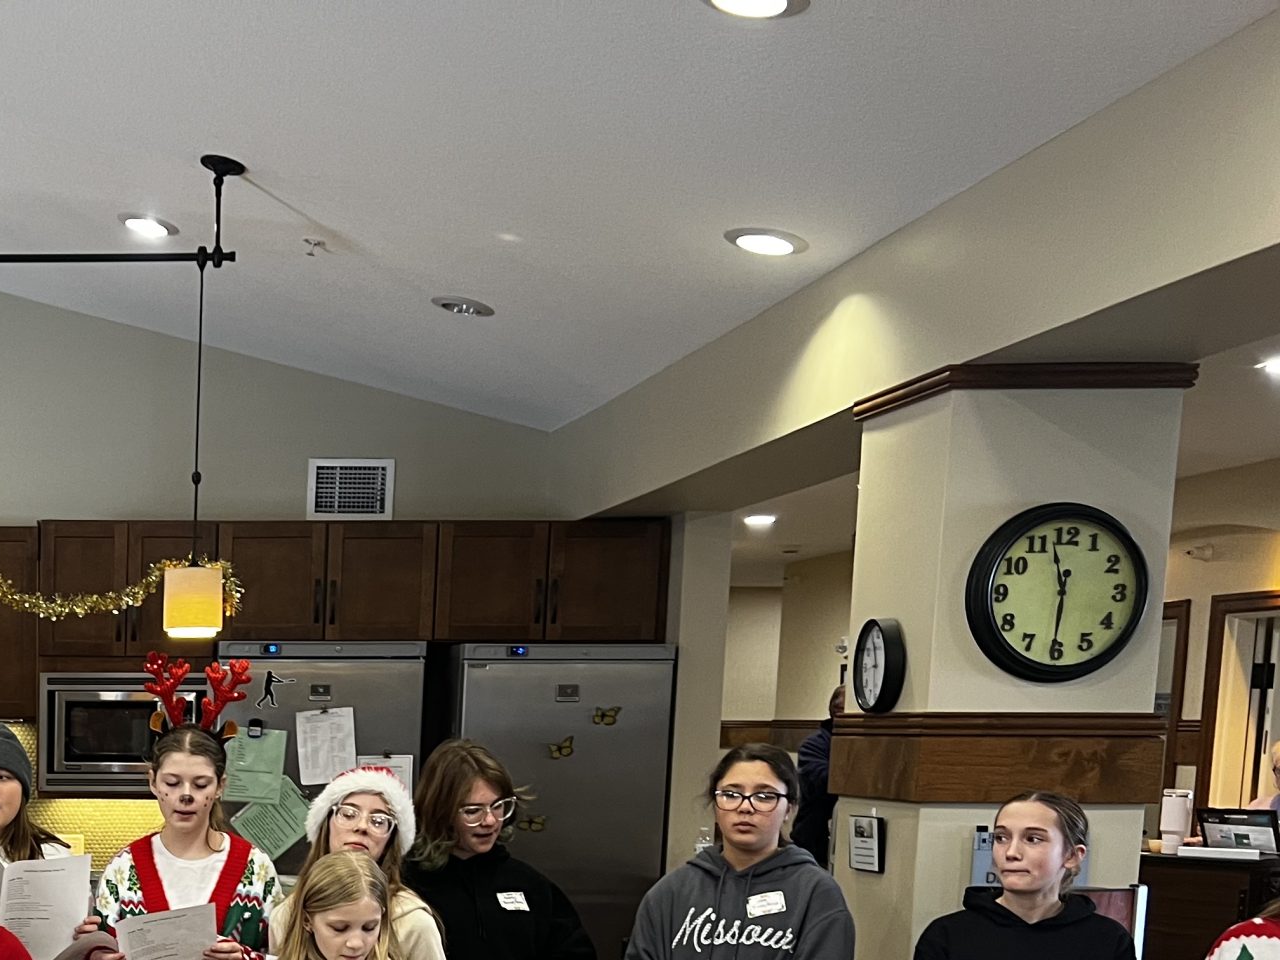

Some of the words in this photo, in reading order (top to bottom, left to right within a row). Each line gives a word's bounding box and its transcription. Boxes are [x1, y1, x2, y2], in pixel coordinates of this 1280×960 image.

[1025, 534, 1049, 554] 11
[1053, 526, 1080, 547] 12
[1088, 533, 1100, 552] 1
[1003, 556, 1028, 575] 10
[1104, 554, 1121, 574] 2
[994, 583, 1009, 603] 9
[1111, 583, 1127, 602] 3
[1000, 613, 1015, 632] 8
[1099, 611, 1114, 630] 4
[1021, 633, 1036, 652] 7
[1049, 640, 1064, 661] 6
[1077, 632, 1094, 651] 5
